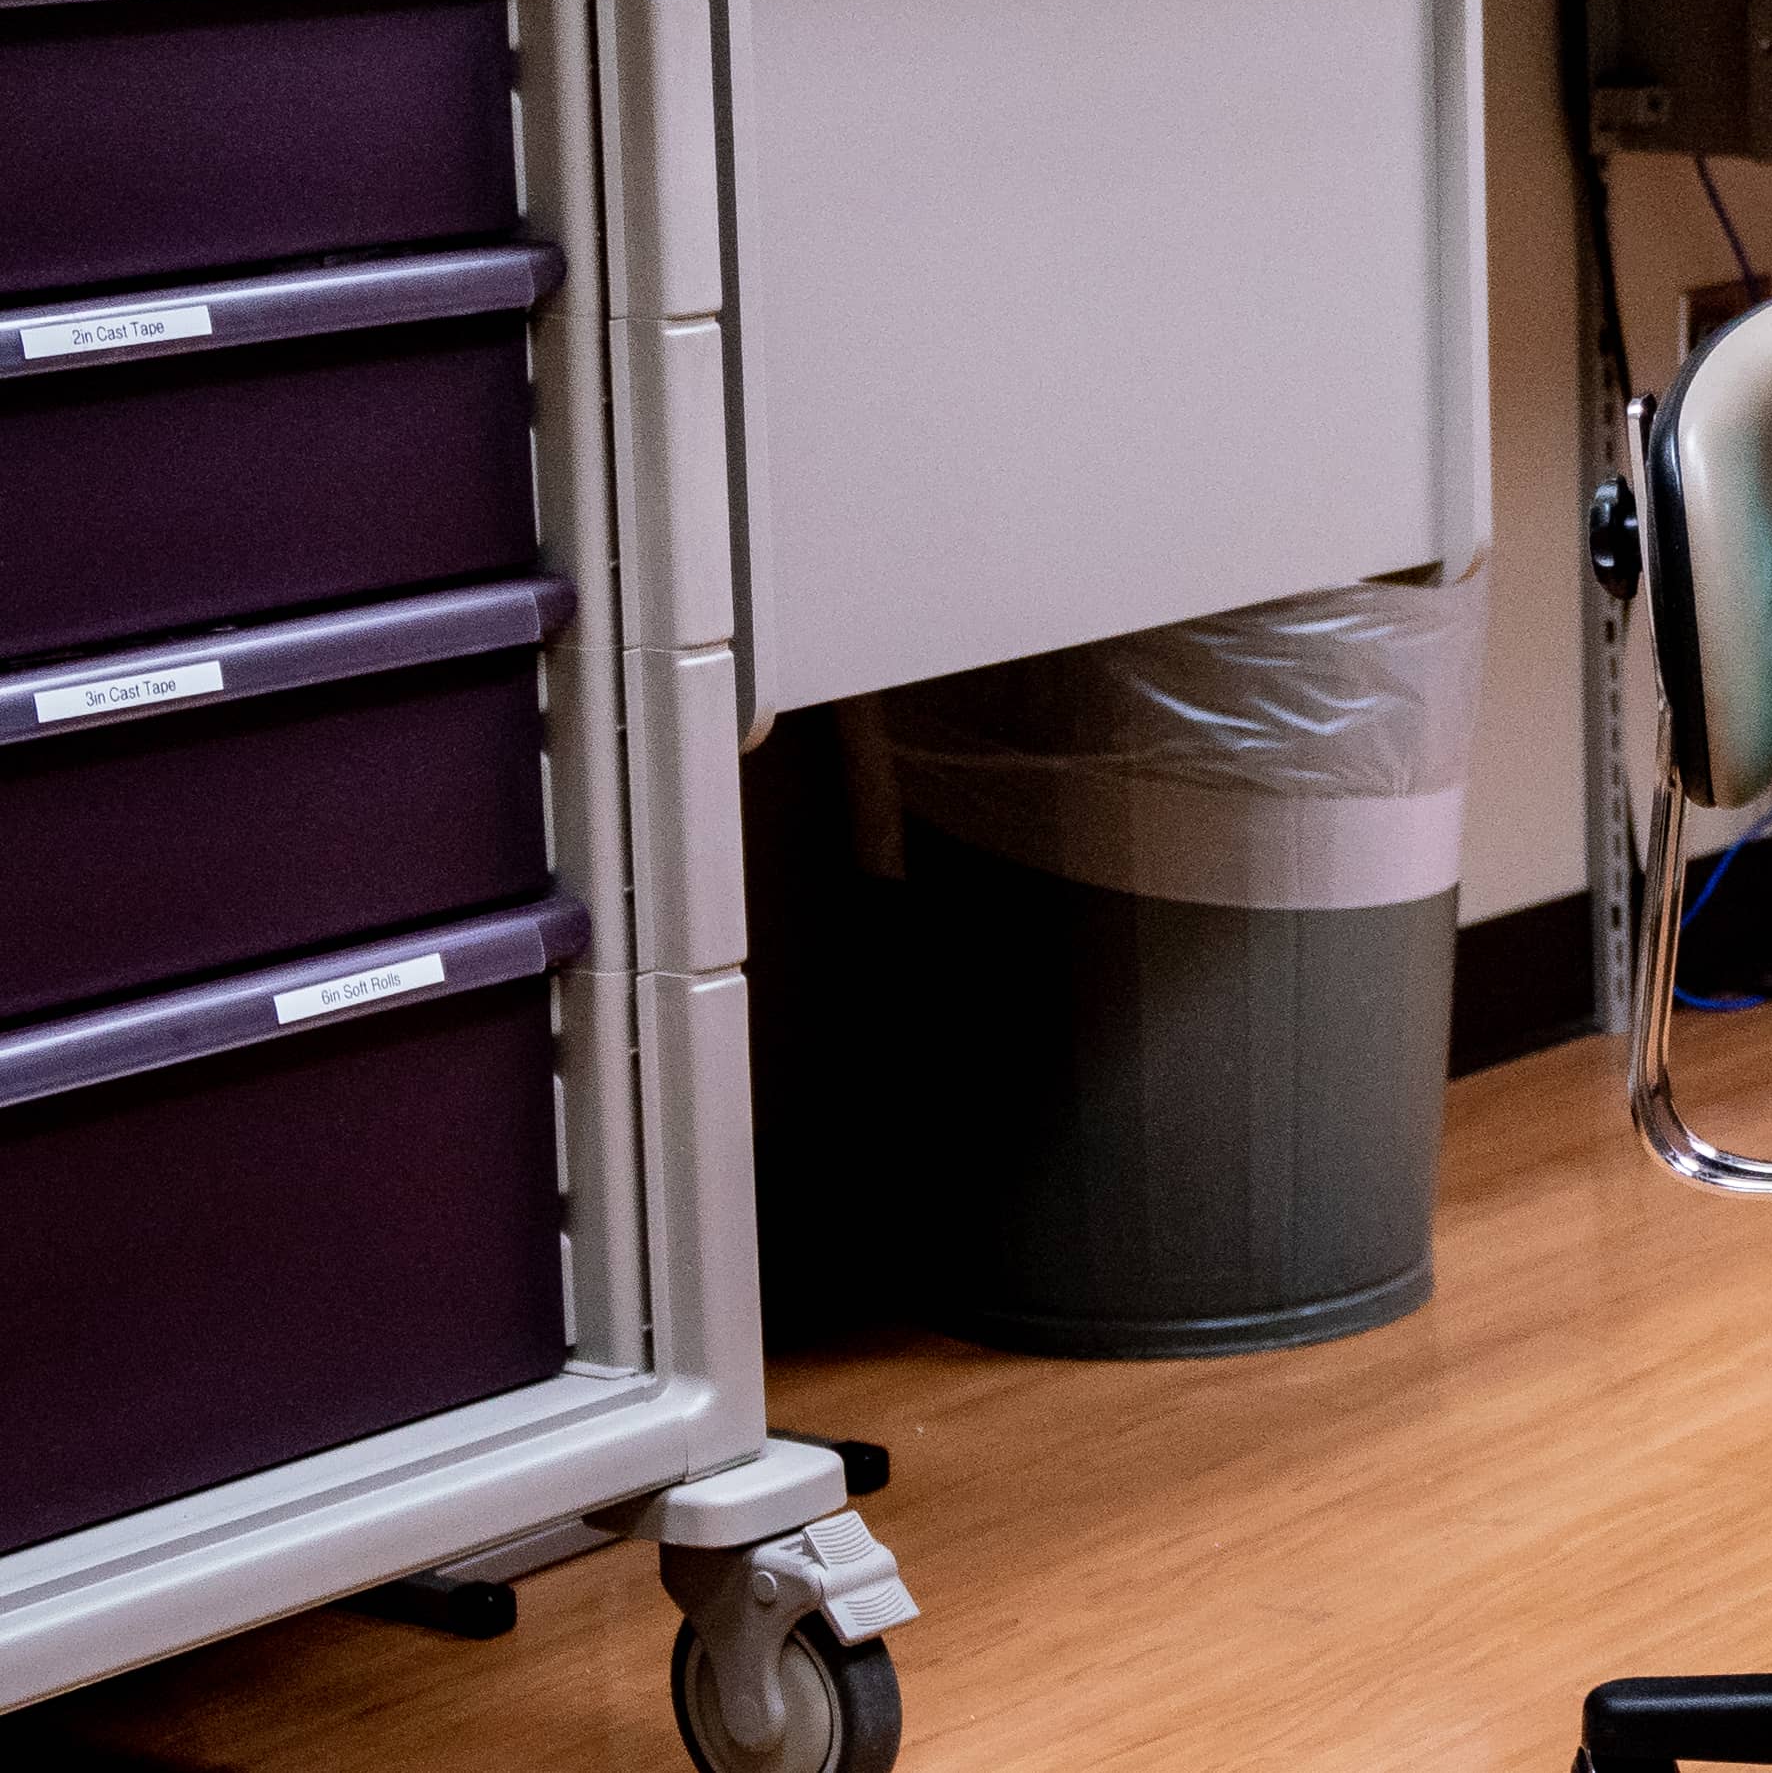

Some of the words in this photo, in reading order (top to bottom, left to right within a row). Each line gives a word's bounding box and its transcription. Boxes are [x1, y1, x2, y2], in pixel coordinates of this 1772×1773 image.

[72, 329, 93, 346] 2in
[96, 325, 128, 342] Cast
[130, 321, 165, 338] Tape
[86, 691, 106, 707] 3in
[109, 685, 140, 702] Cast
[144, 679, 176, 695] Tape
[321, 989, 341, 1005] 6in
[344, 982, 369, 1000] Soft
[371, 973, 401, 992] Rolls
